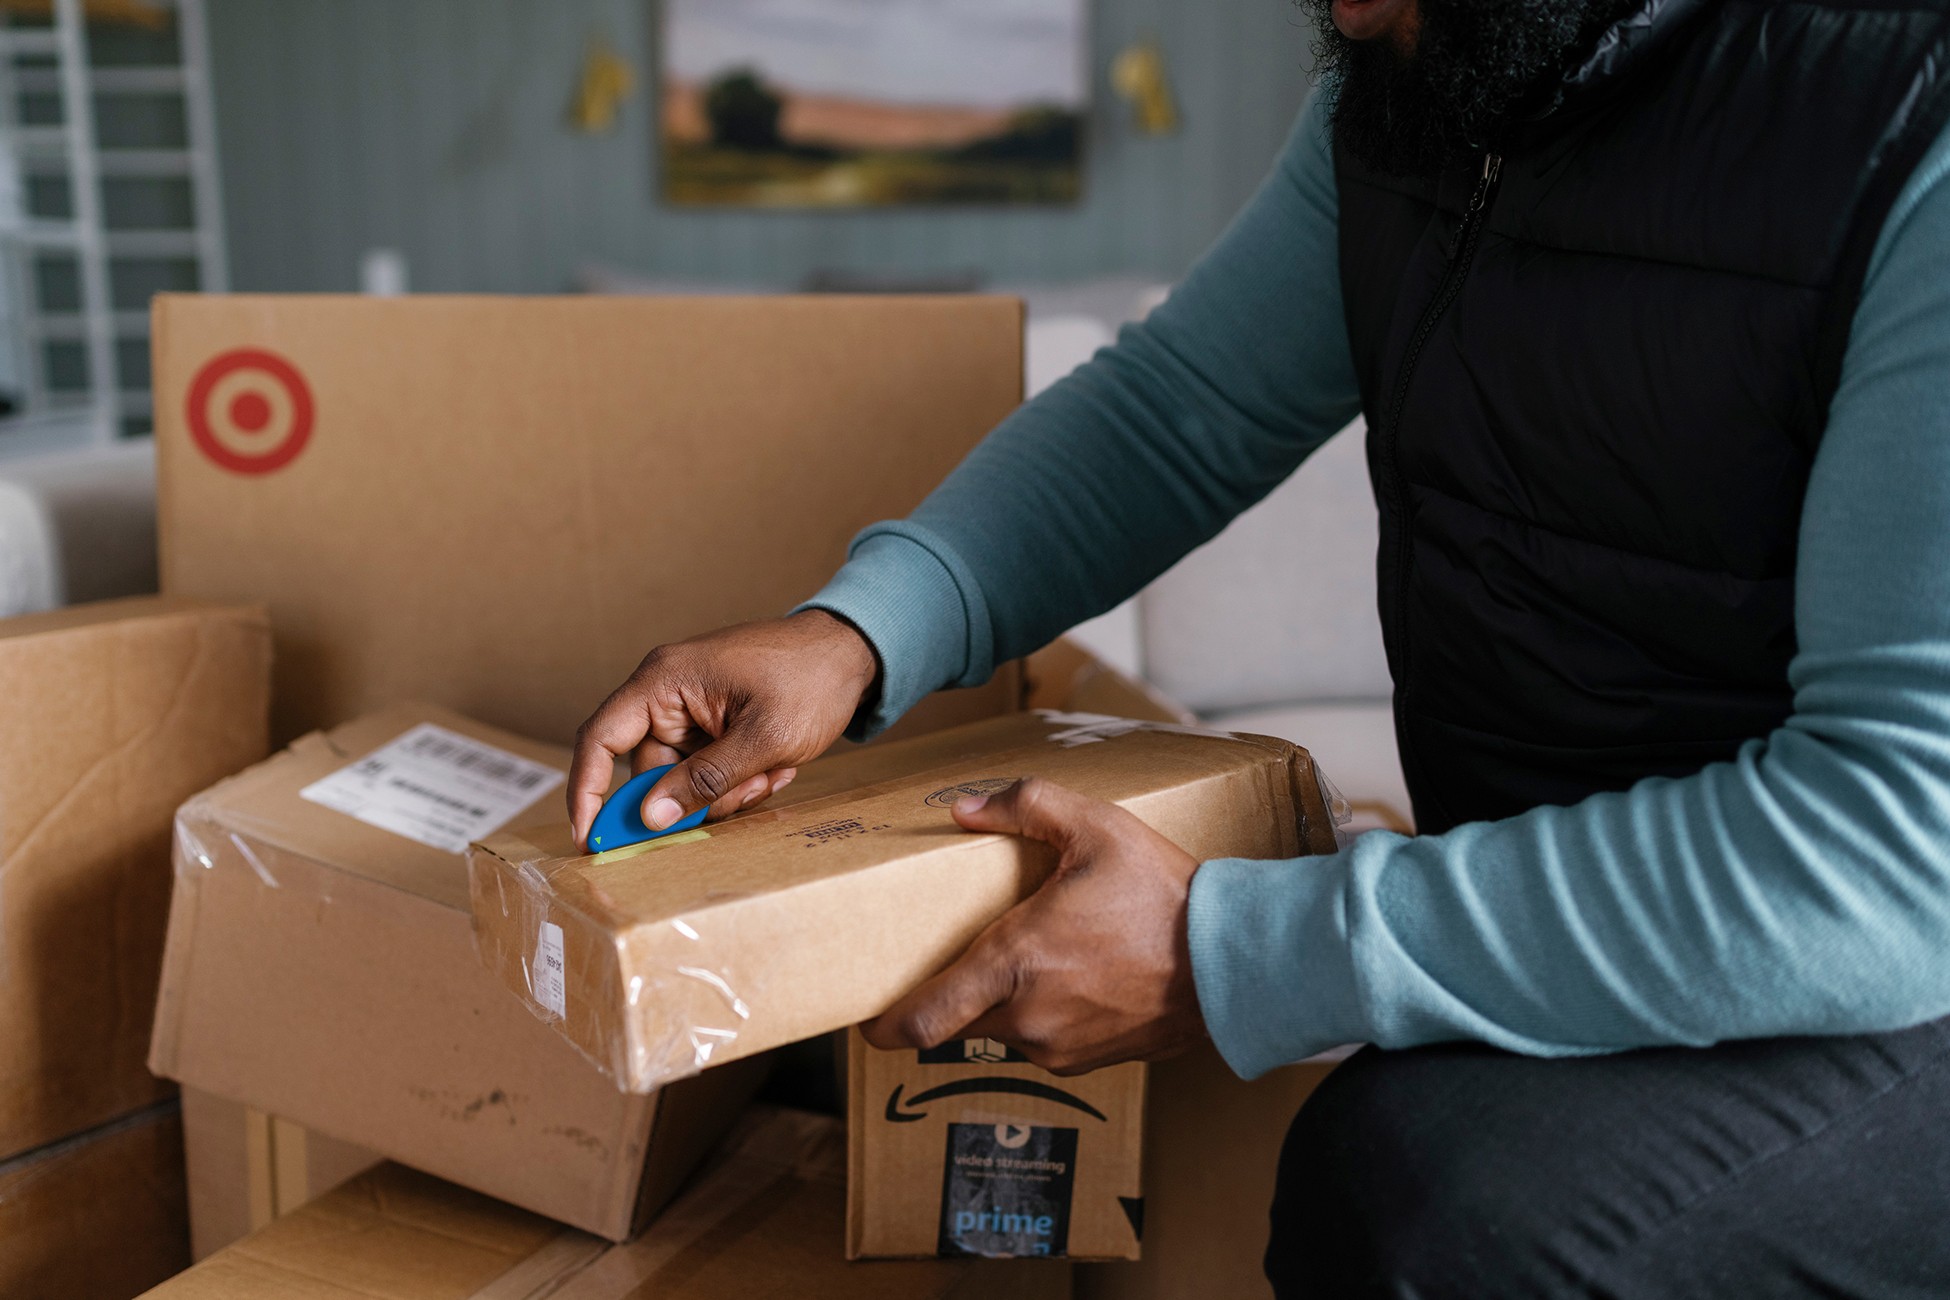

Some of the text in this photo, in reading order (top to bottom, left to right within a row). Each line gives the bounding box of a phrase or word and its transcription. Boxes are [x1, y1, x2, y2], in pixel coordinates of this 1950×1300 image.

[954, 1154, 1066, 1174] video streaming
[954, 1205, 1053, 1236] prime
